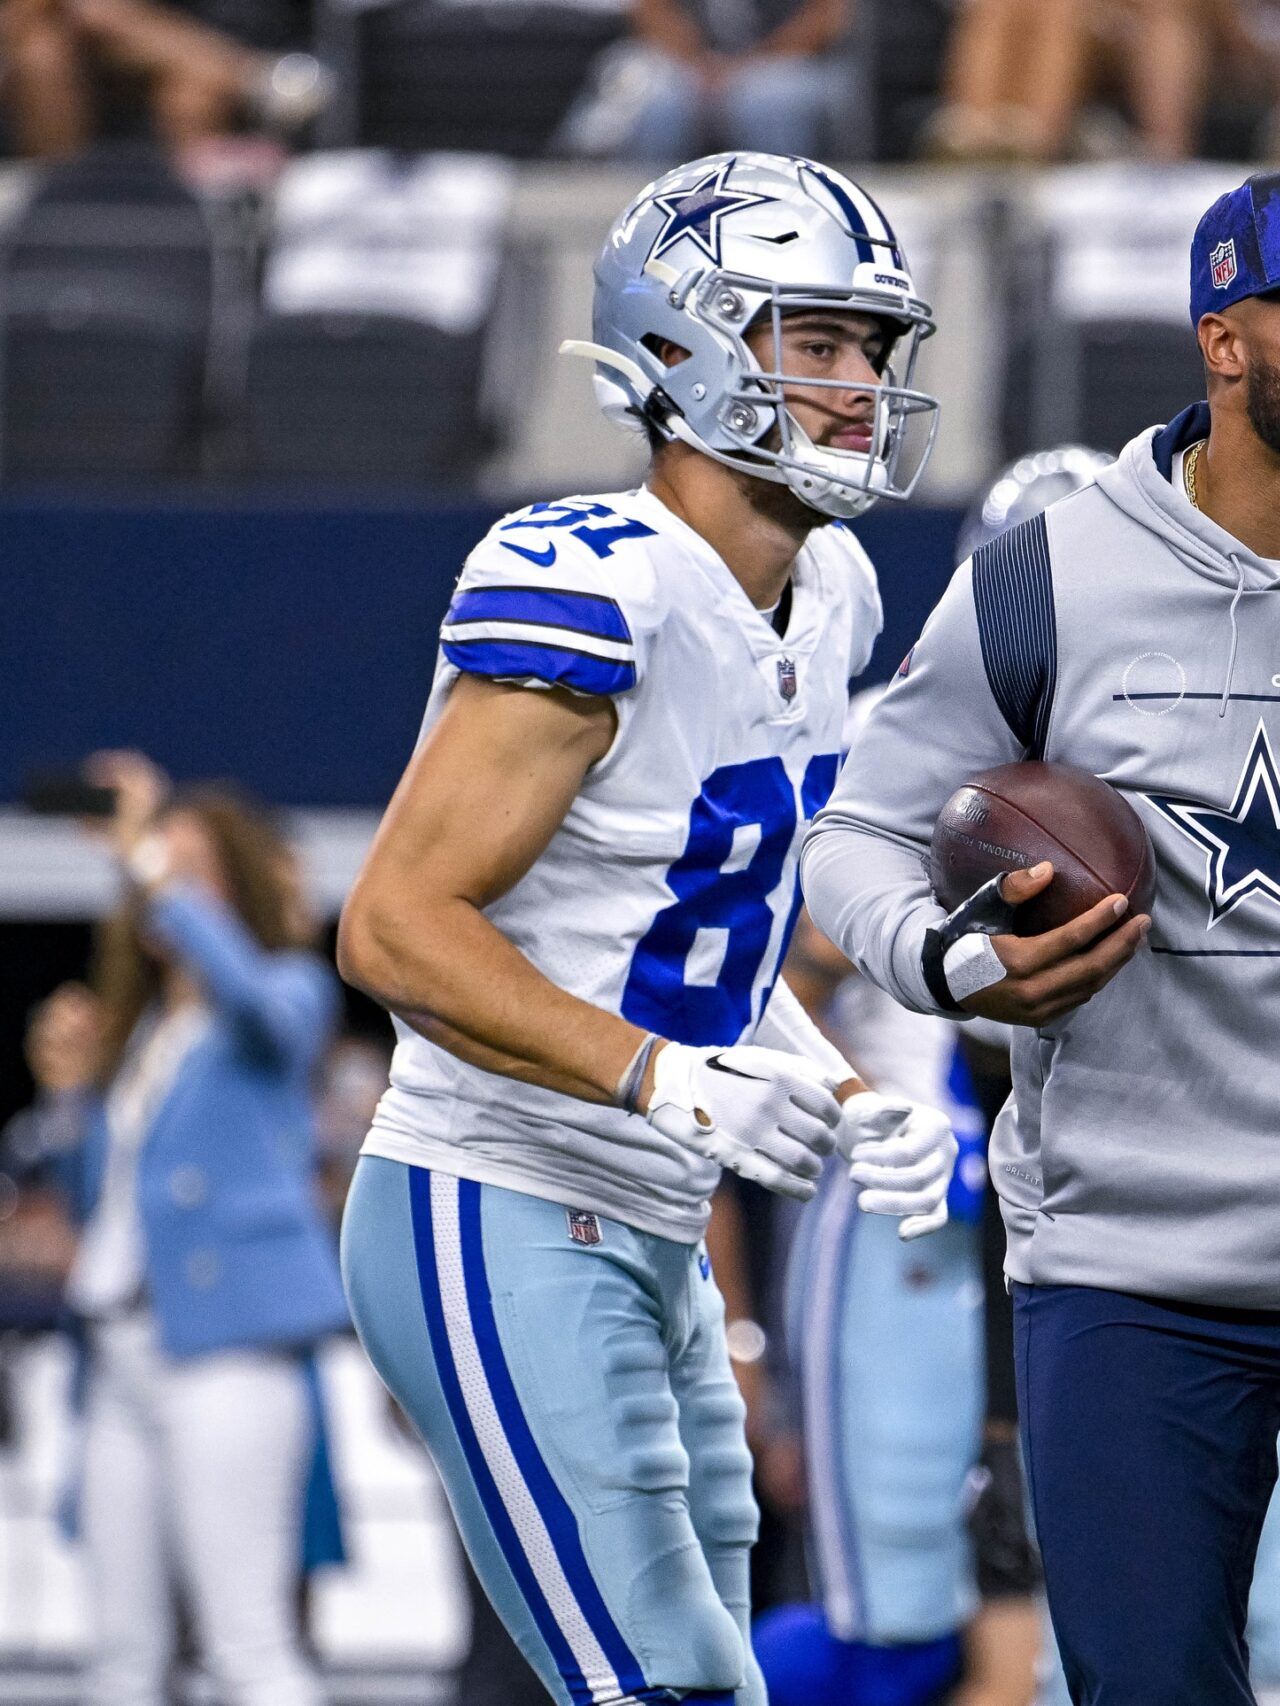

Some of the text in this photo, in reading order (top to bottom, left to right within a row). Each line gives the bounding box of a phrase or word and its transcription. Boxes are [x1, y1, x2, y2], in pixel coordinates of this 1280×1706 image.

[1213, 256, 1234, 286] NFL
[978, 840, 1029, 866] NATIONAL
[1005, 1164, 1041, 1186] DRI-FIT
